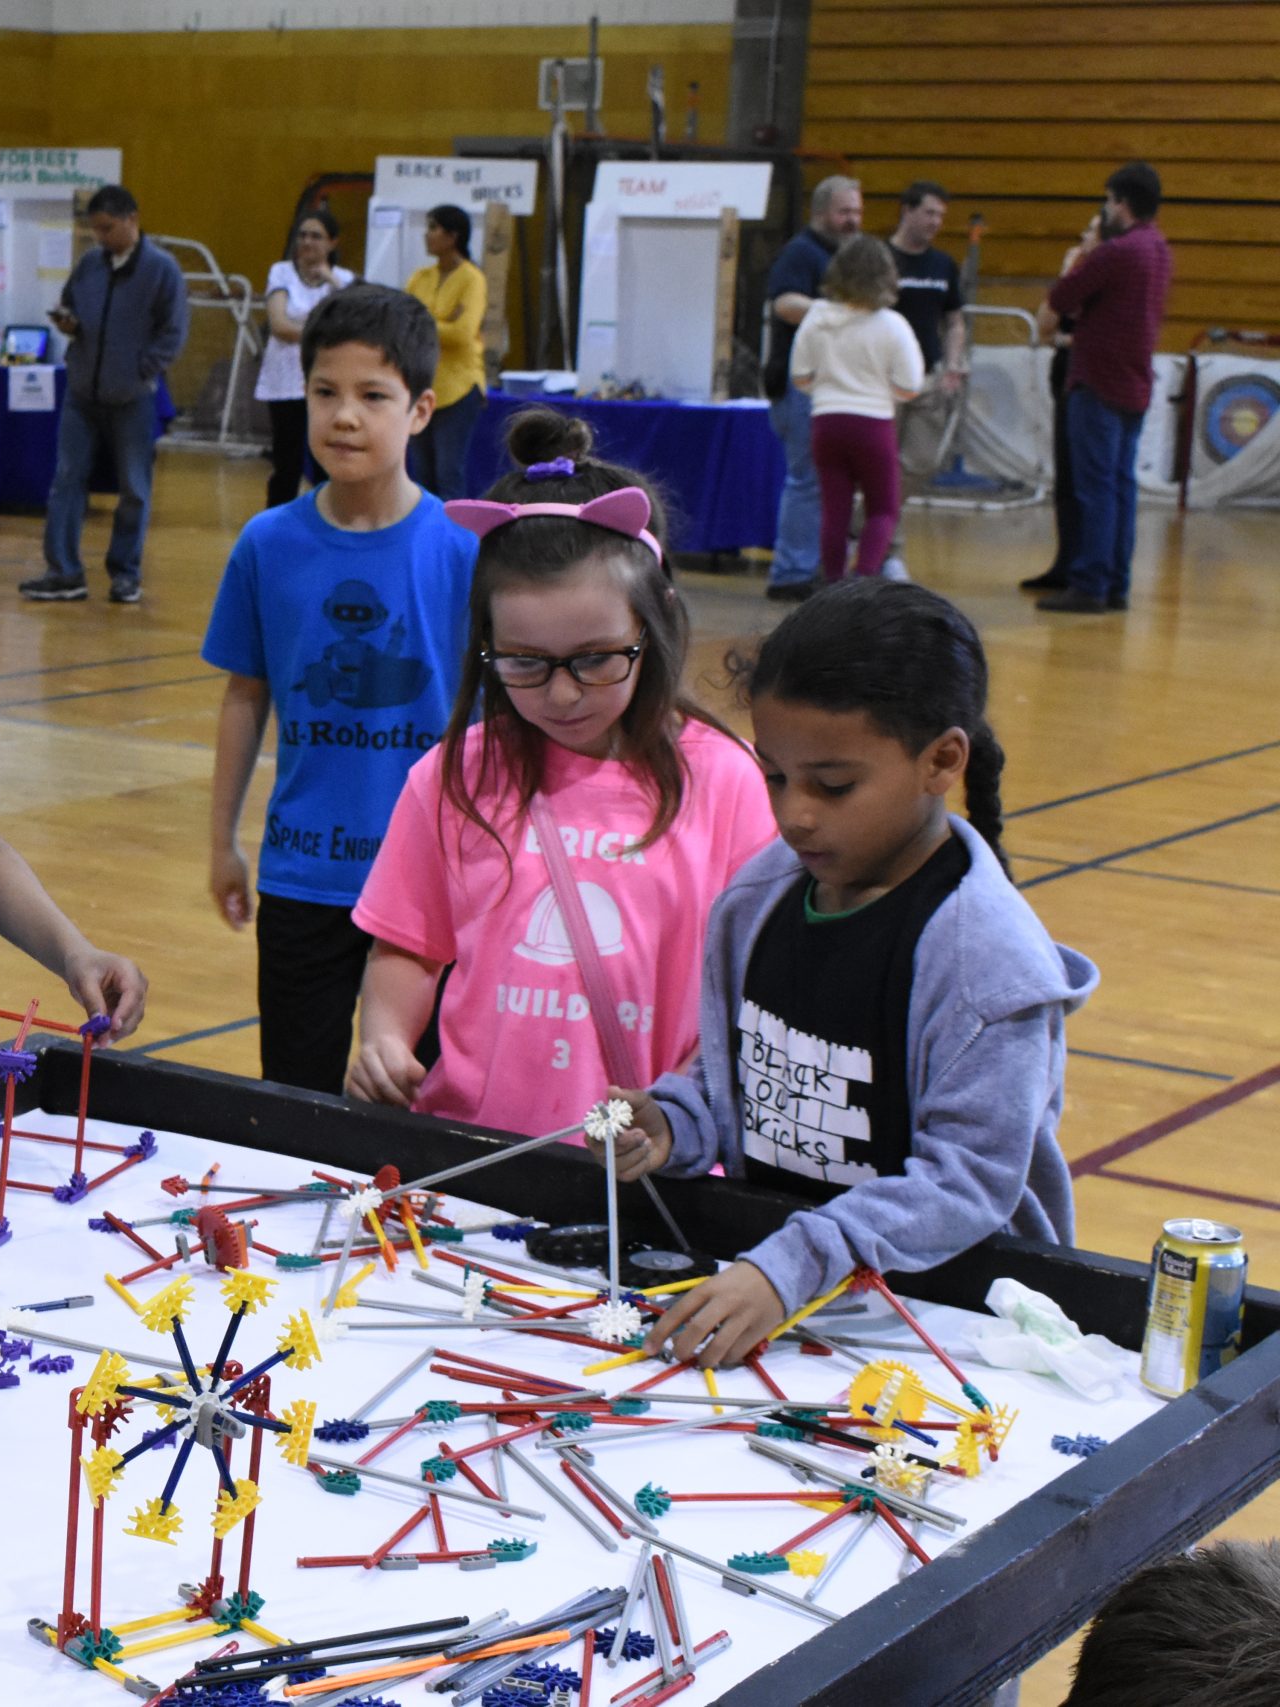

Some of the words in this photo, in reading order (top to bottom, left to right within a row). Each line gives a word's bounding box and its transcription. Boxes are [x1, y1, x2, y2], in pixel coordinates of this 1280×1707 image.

[395, 162, 443, 178] BLACK
[471, 183, 524, 202] BRICKS
[619, 177, 668, 196] TEAM
[551, 1039, 571, 1070] 3
[753, 1032, 831, 1092] BLACK
[756, 1079, 810, 1120] OUT
